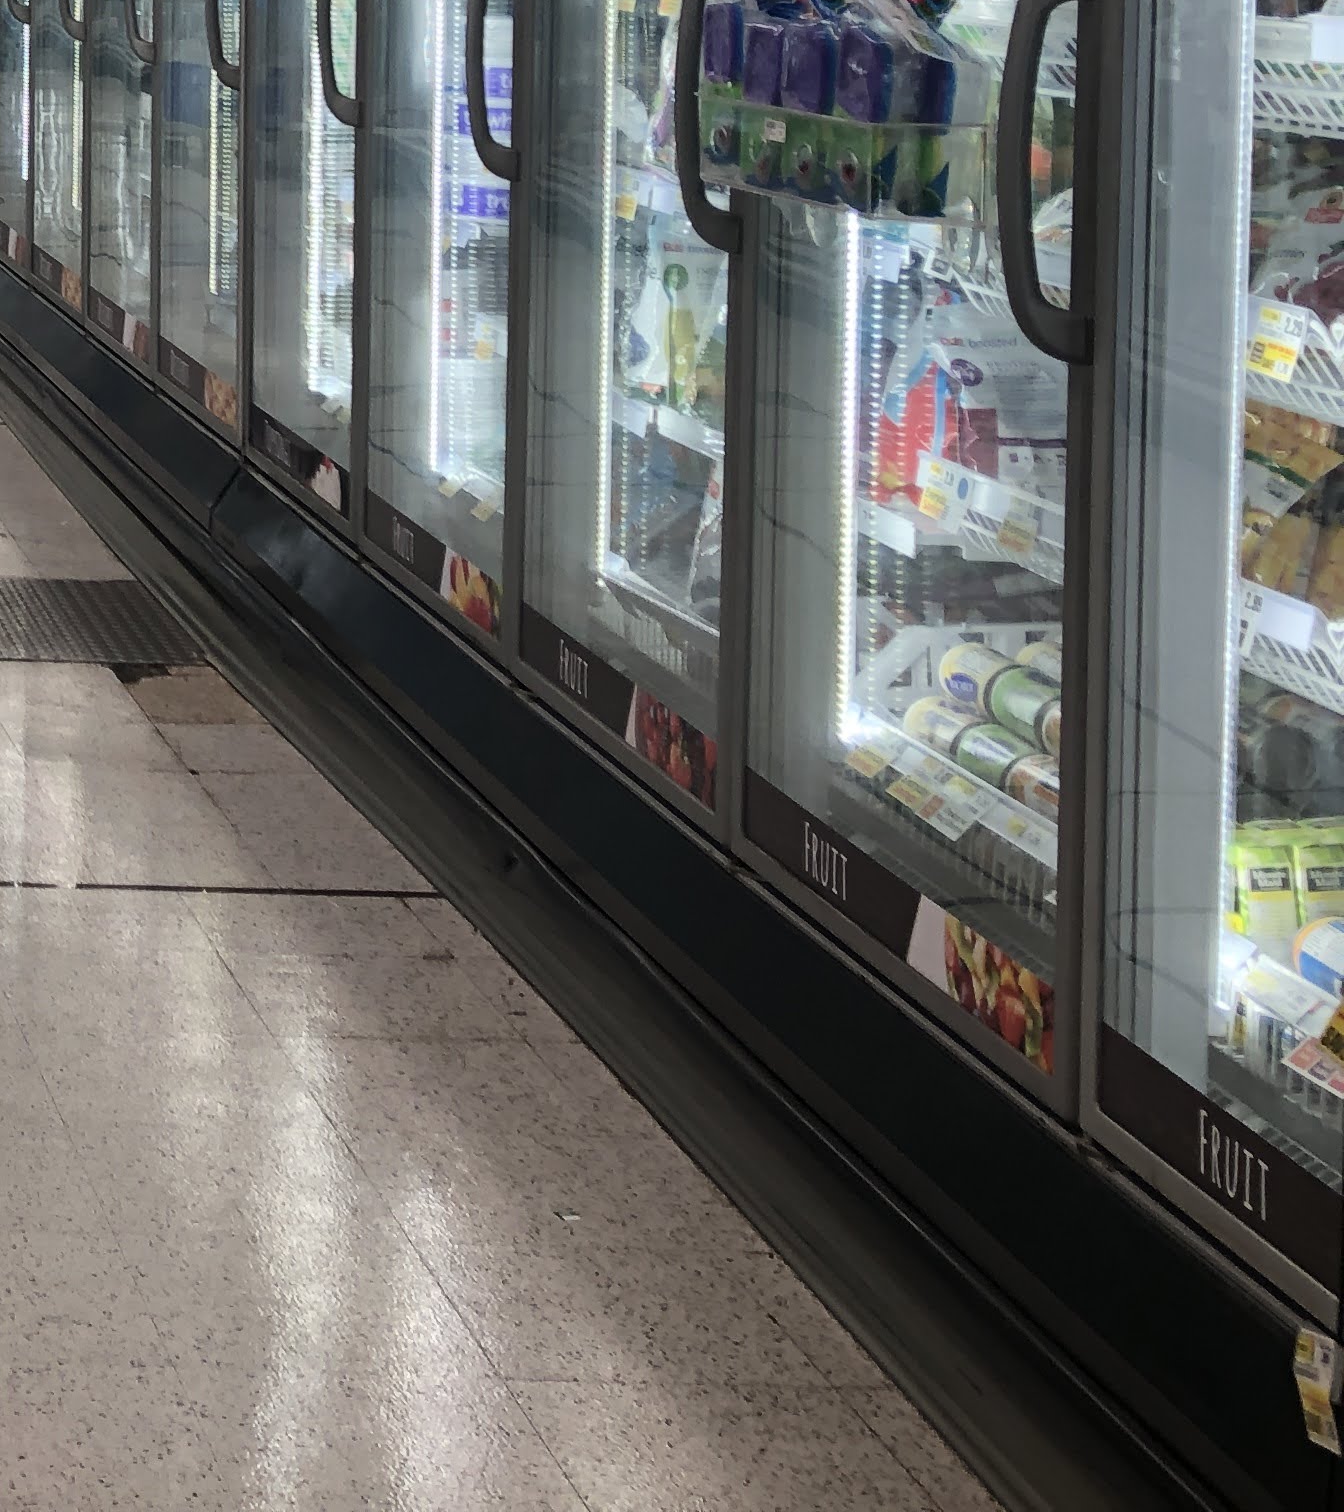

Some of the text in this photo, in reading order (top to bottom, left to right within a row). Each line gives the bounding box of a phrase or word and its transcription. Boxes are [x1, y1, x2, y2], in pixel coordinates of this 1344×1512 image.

[559, 639, 589, 698] FRUIT
[803, 821, 848, 901] FRUIT
[1199, 1109, 1269, 1222] FRUIT
